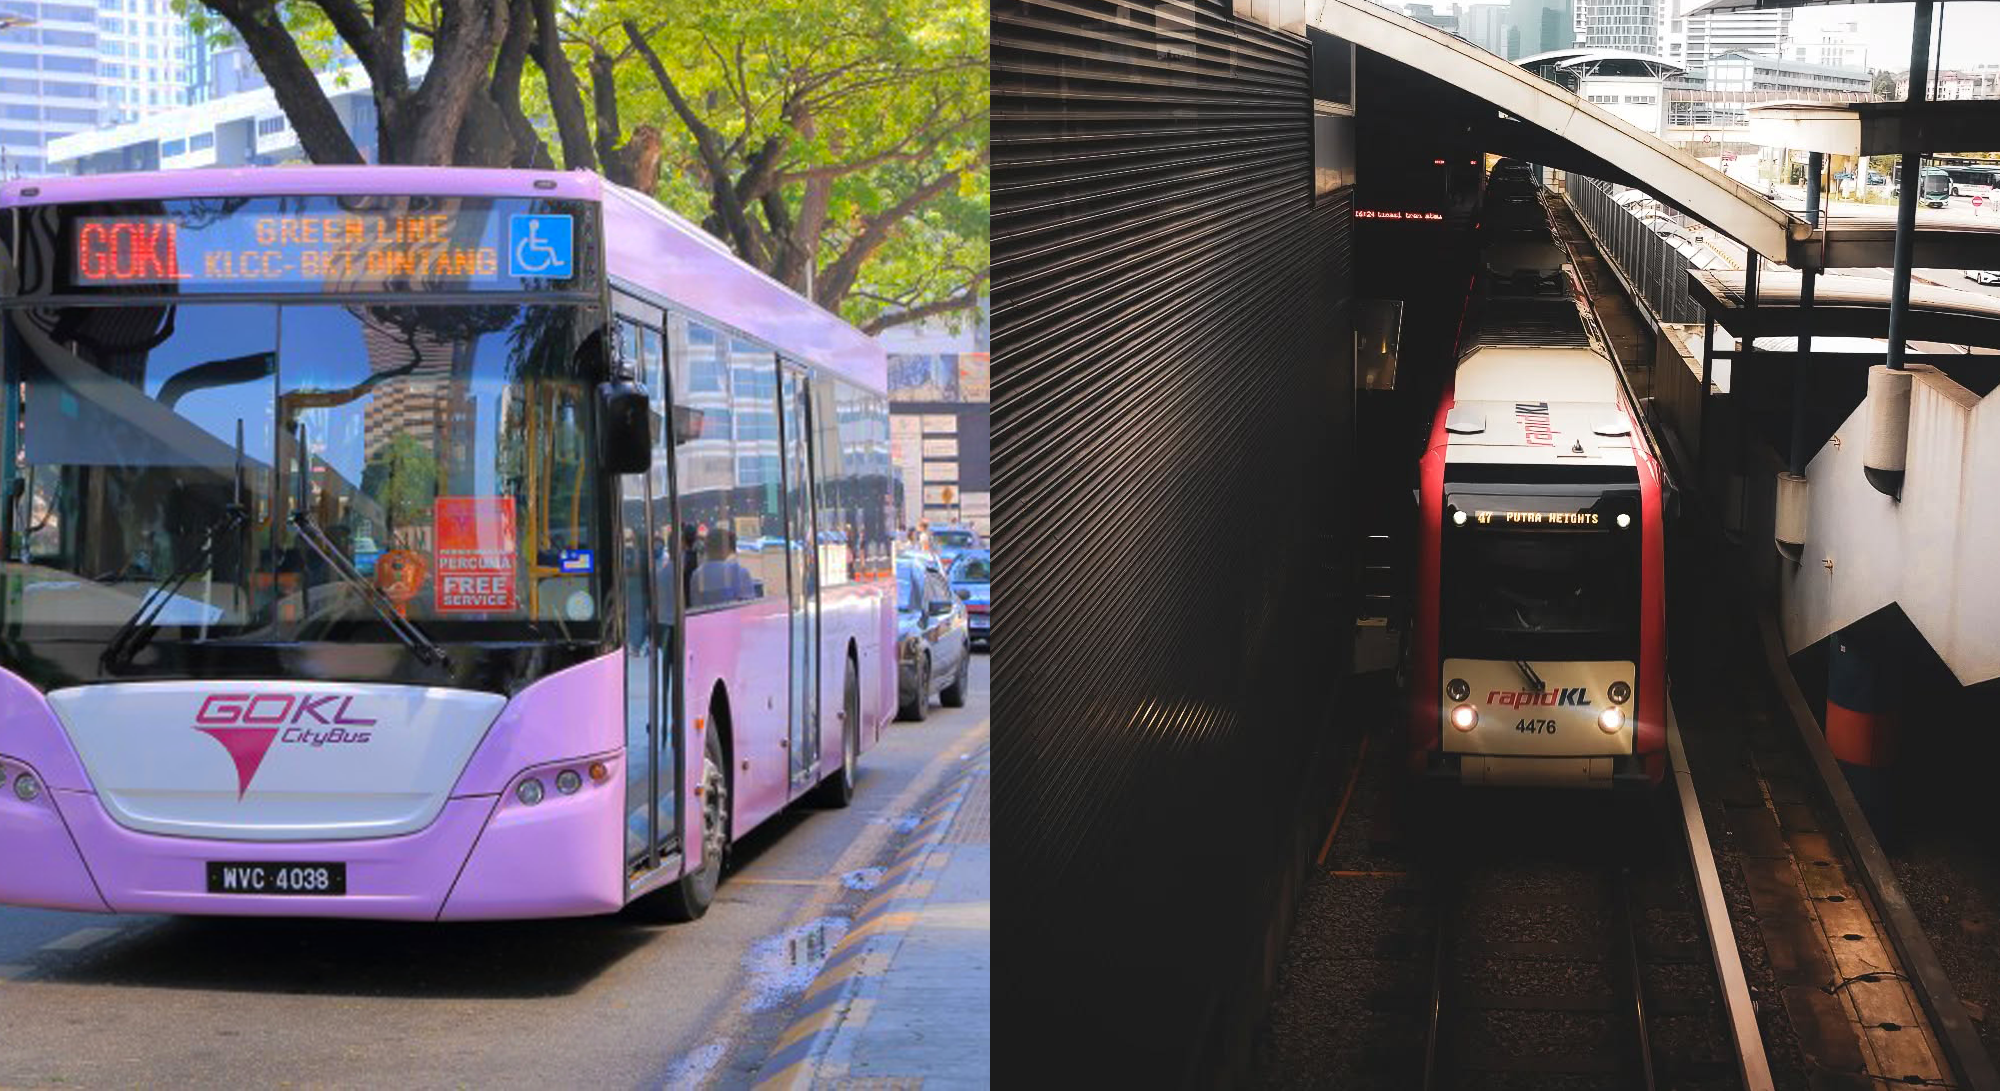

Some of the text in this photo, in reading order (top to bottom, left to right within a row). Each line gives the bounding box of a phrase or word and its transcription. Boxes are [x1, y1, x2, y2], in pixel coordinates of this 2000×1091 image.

[256, 214, 448, 246] GREEN LINE
[80, 223, 190, 278] GOKL
[1477, 511, 1599, 524] 47 PUTRA HEIGHTS
[439, 557, 512, 569] PERCUMA
[443, 576, 507, 594] FREE
[443, 595, 507, 605] SERVICE
[1486, 687, 1592, 710] rapidKL
[196, 694, 377, 725] GOKL
[282, 727, 371, 747] CityBus
[1515, 719, 1556, 735] 4476
[223, 867, 330, 890] WVC 4038
